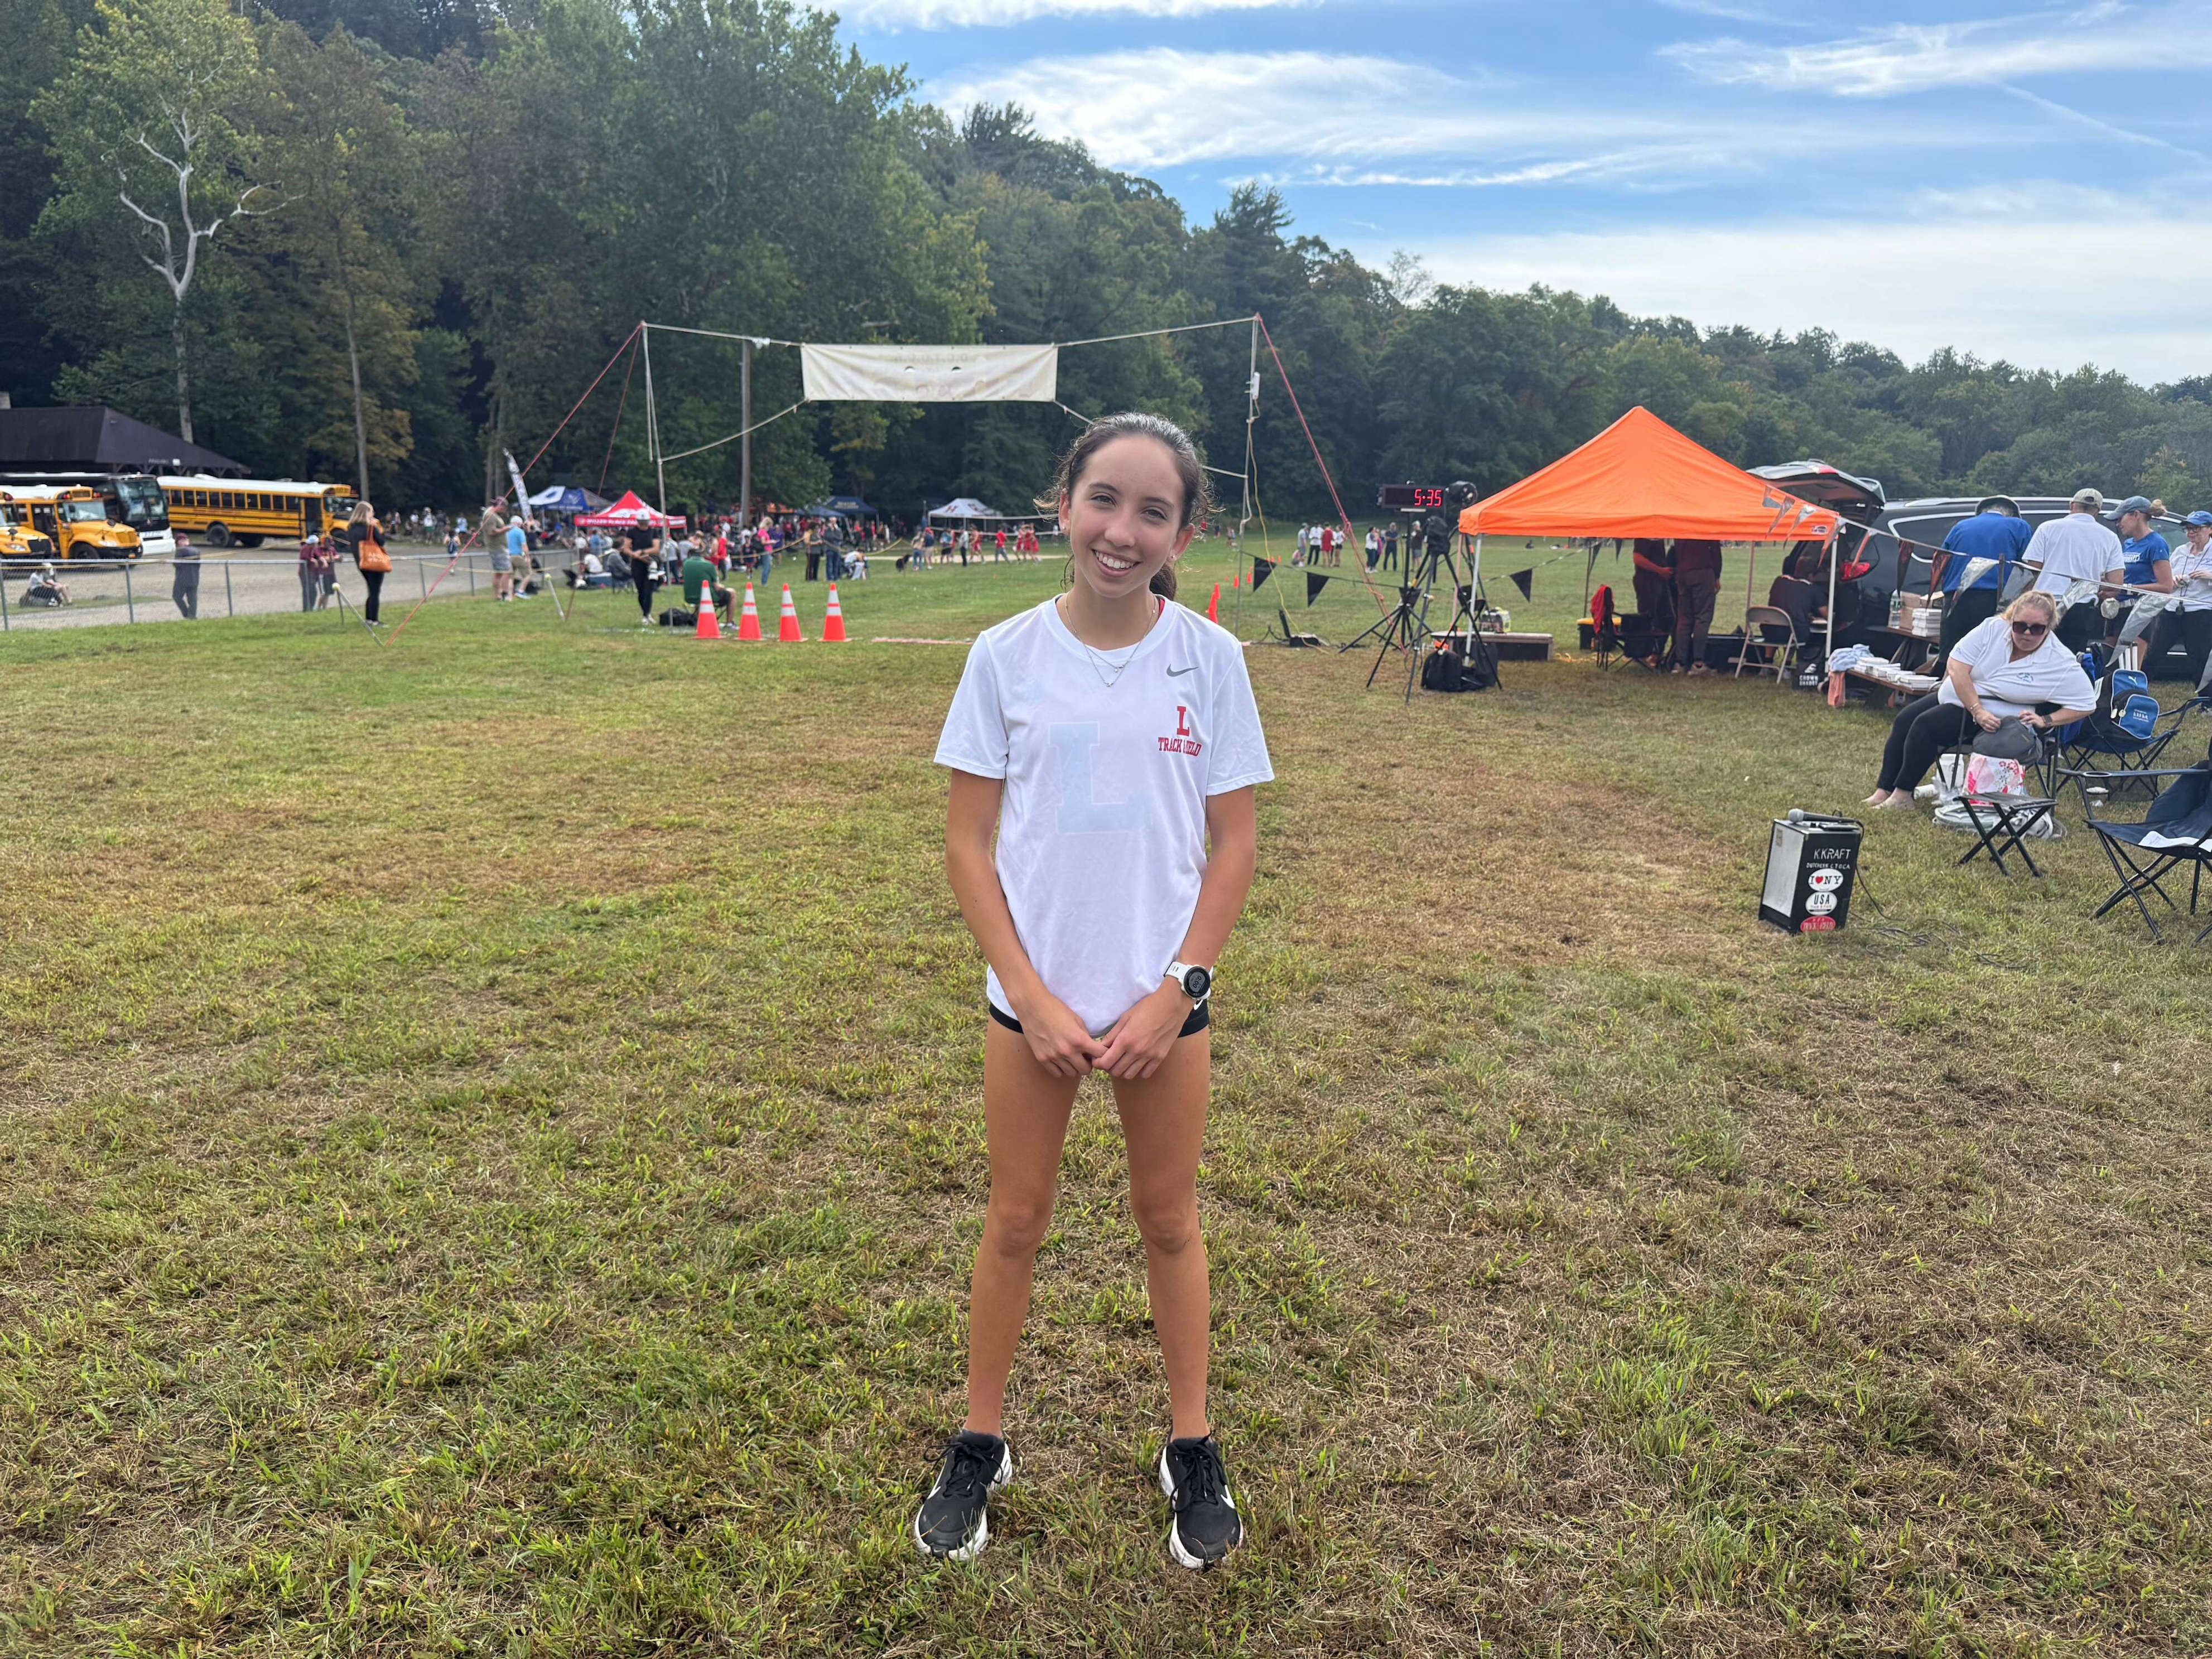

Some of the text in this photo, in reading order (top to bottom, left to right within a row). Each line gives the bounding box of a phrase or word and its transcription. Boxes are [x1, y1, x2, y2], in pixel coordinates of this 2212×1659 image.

[1177, 706, 1190, 736] L
[1158, 737, 1182, 753] TRACK
[1810, 876, 1842, 885] I NY
[1814, 894, 1830, 904] USA
